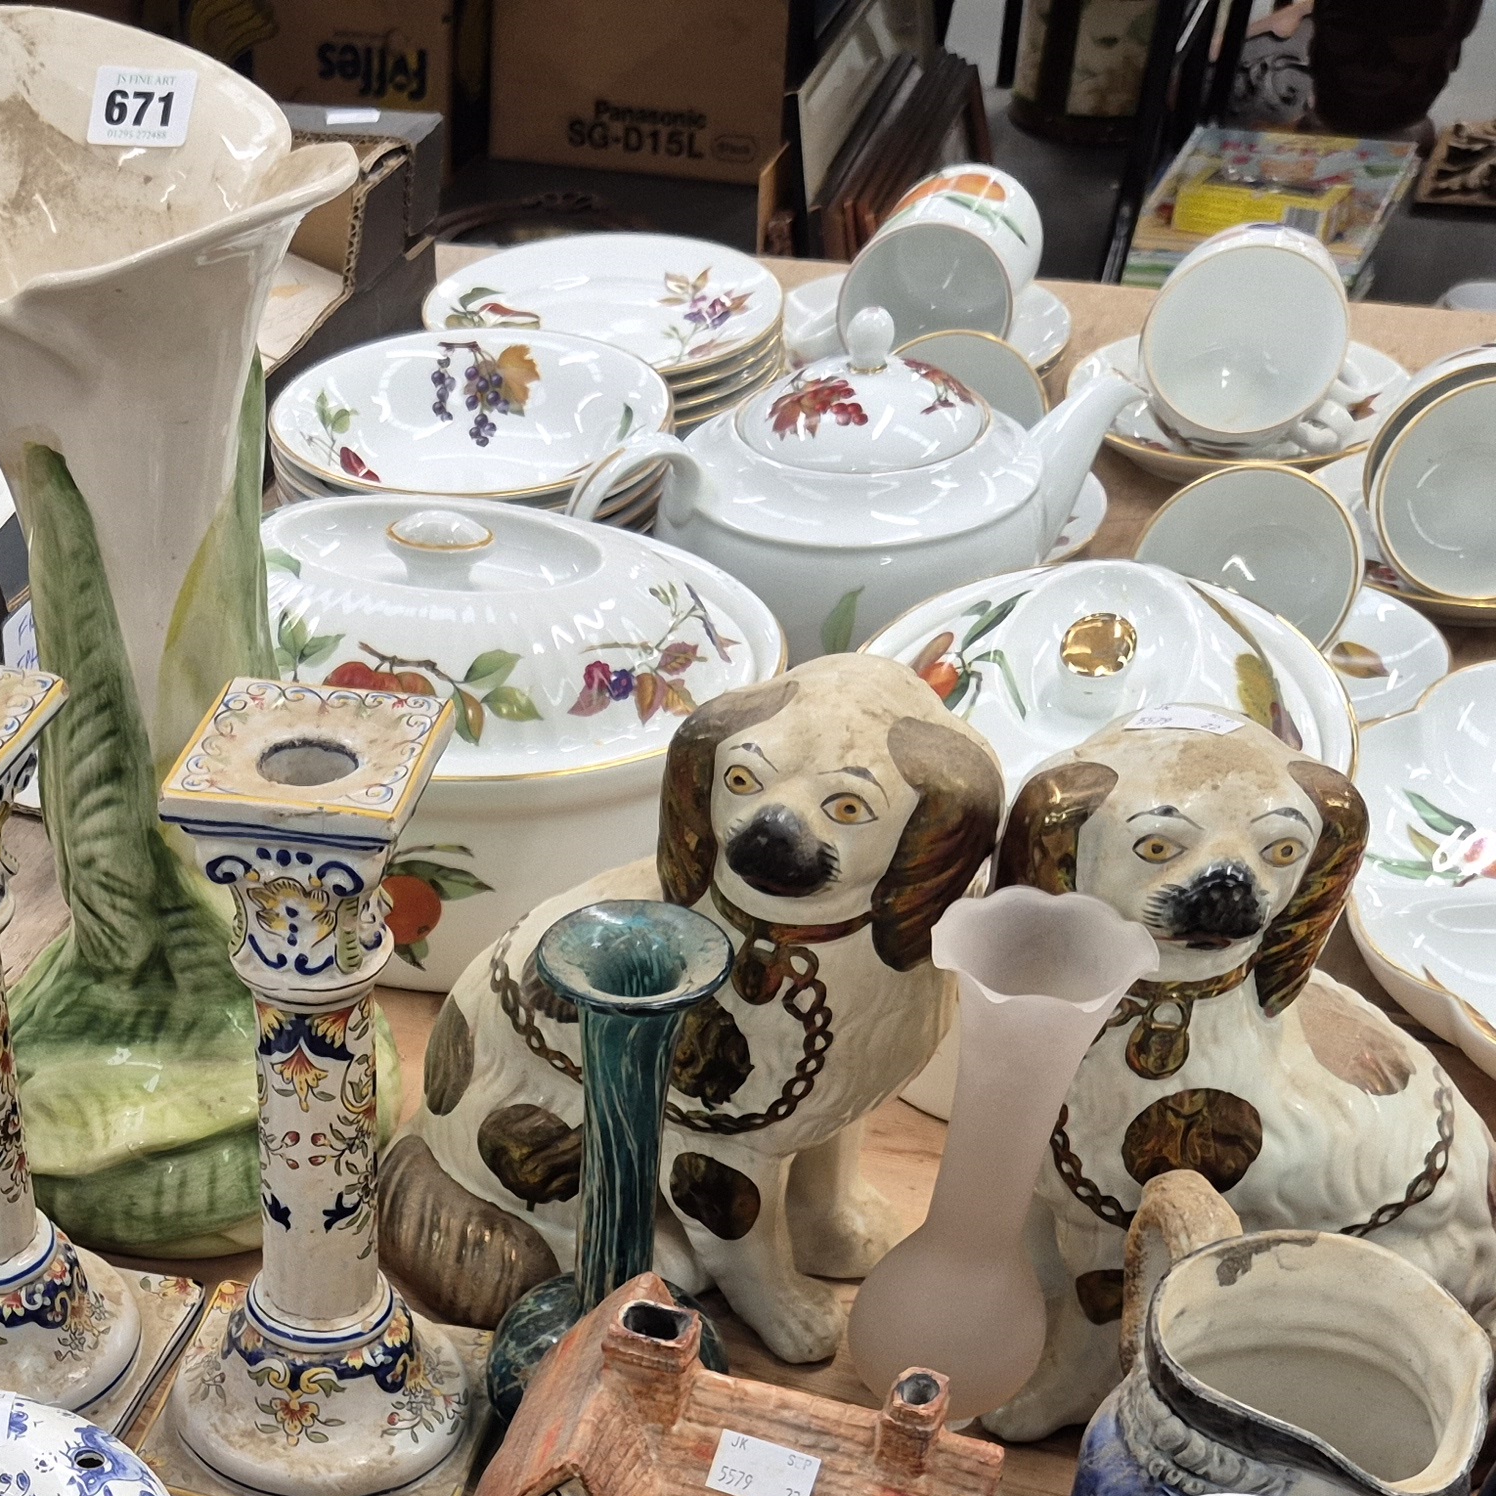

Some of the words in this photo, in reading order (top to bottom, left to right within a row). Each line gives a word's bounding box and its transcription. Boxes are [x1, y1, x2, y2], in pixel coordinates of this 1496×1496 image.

[129, 74, 153, 85] FINE
[156, 76, 177, 86] ART
[105, 89, 175, 127] 671
[595, 100, 706, 130] Panasonic
[568, 118, 703, 160] SG-D15L
[731, 1436, 749, 1450] JK
[787, 1454, 812, 1470] SEP
[718, 1465, 753, 1490] 5579
